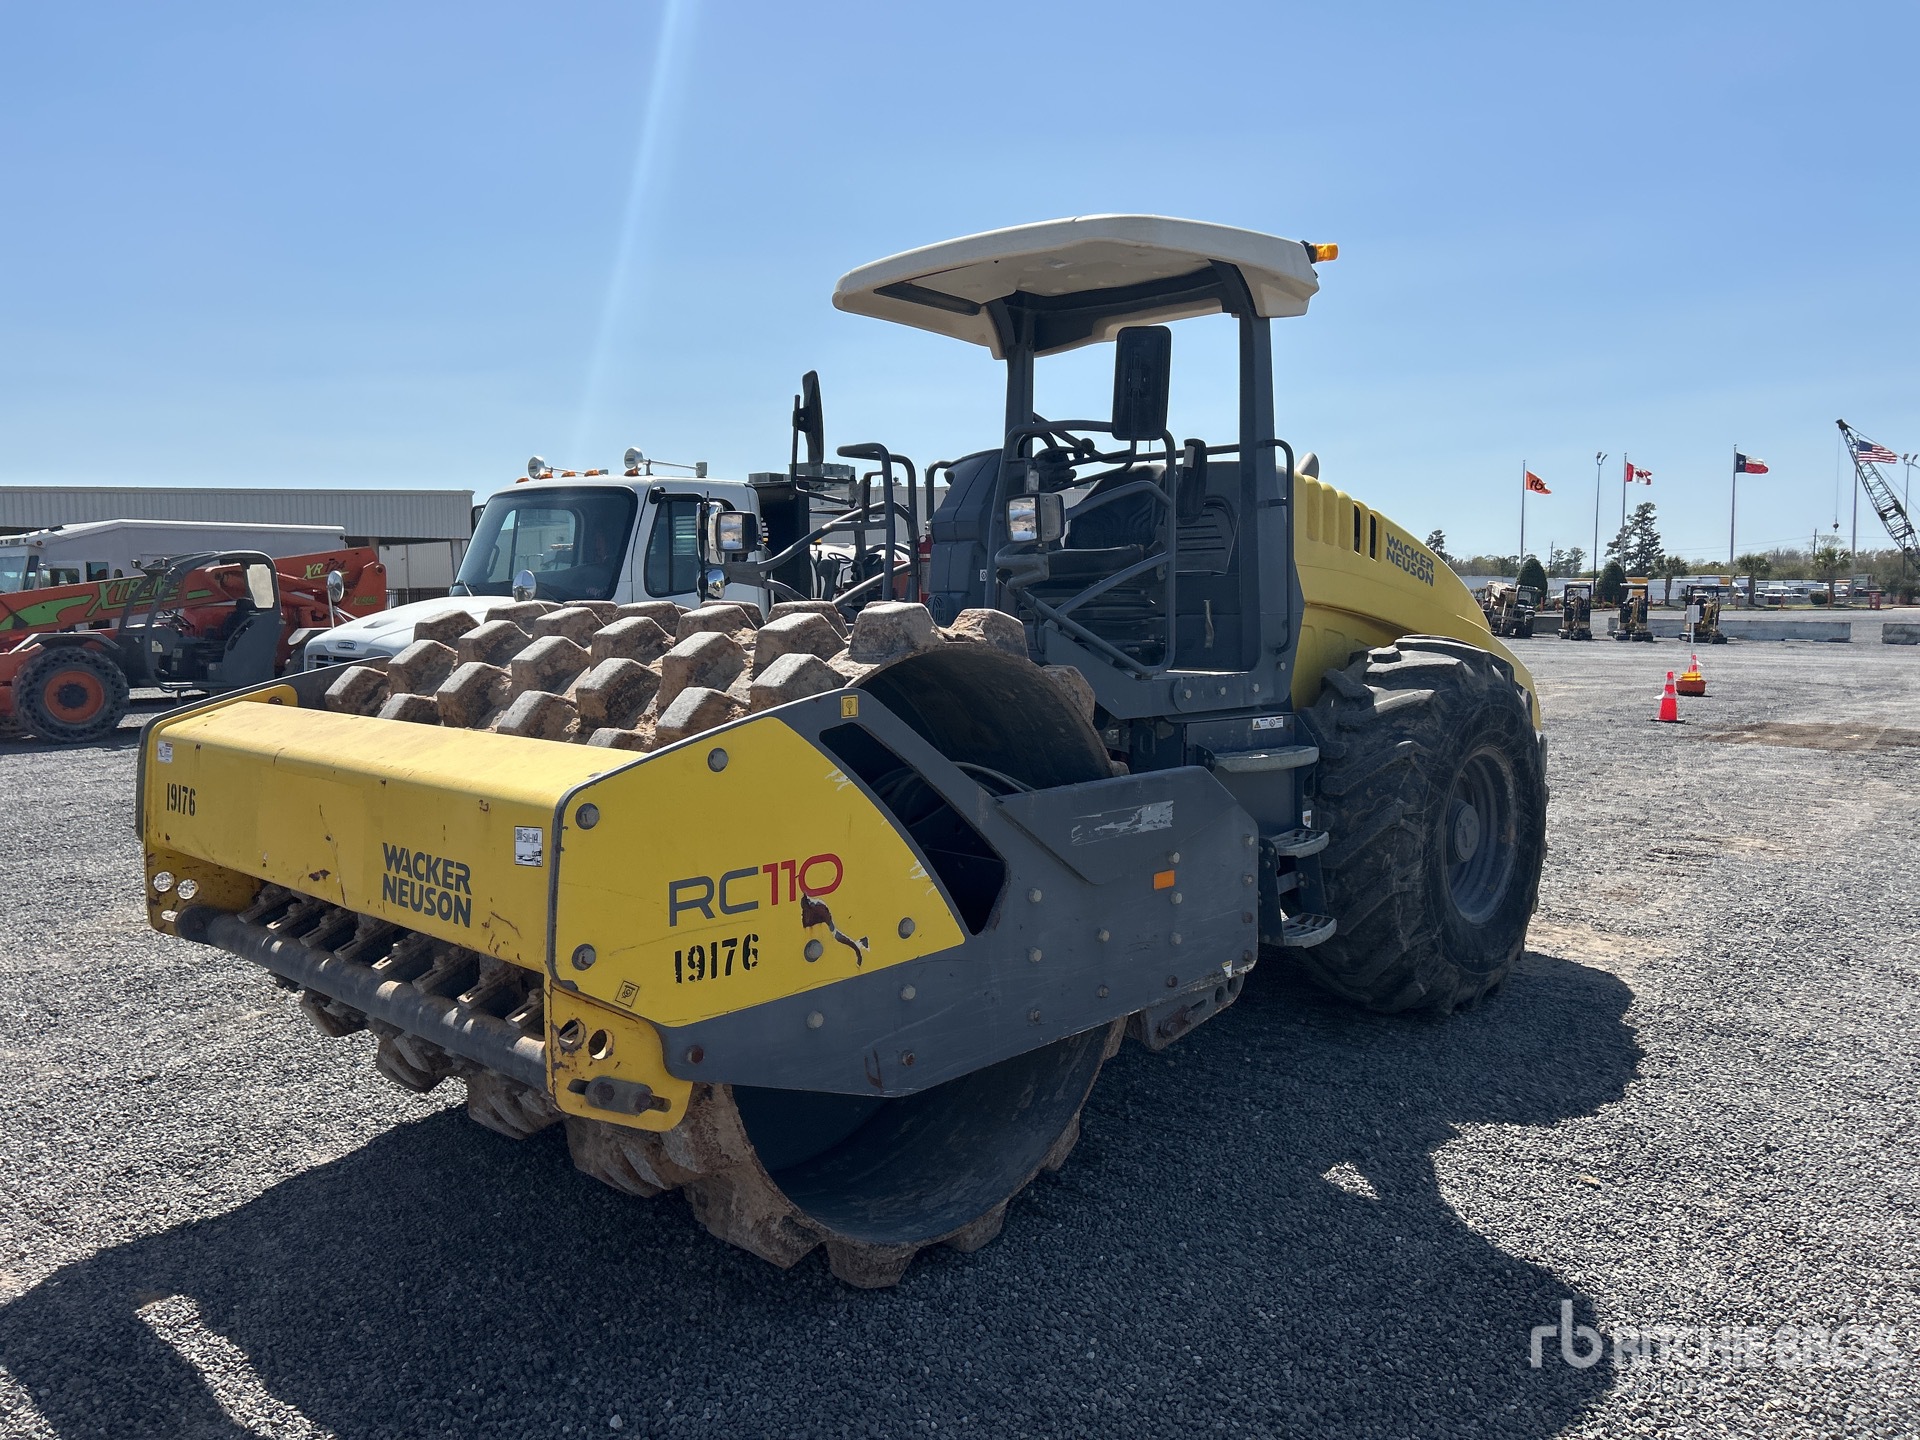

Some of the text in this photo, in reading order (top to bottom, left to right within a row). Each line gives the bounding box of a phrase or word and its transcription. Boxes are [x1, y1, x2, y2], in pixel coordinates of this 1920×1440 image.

[303, 562, 324, 579] XR
[1386, 532, 1434, 573] WACKER
[1386, 546, 1434, 587] NEUSON
[167, 782, 196, 816] 19176
[382, 842, 472, 896] WACKER
[668, 853, 844, 927] RC110
[382, 872, 472, 928] NEUSON
[674, 933, 760, 984] 19176
